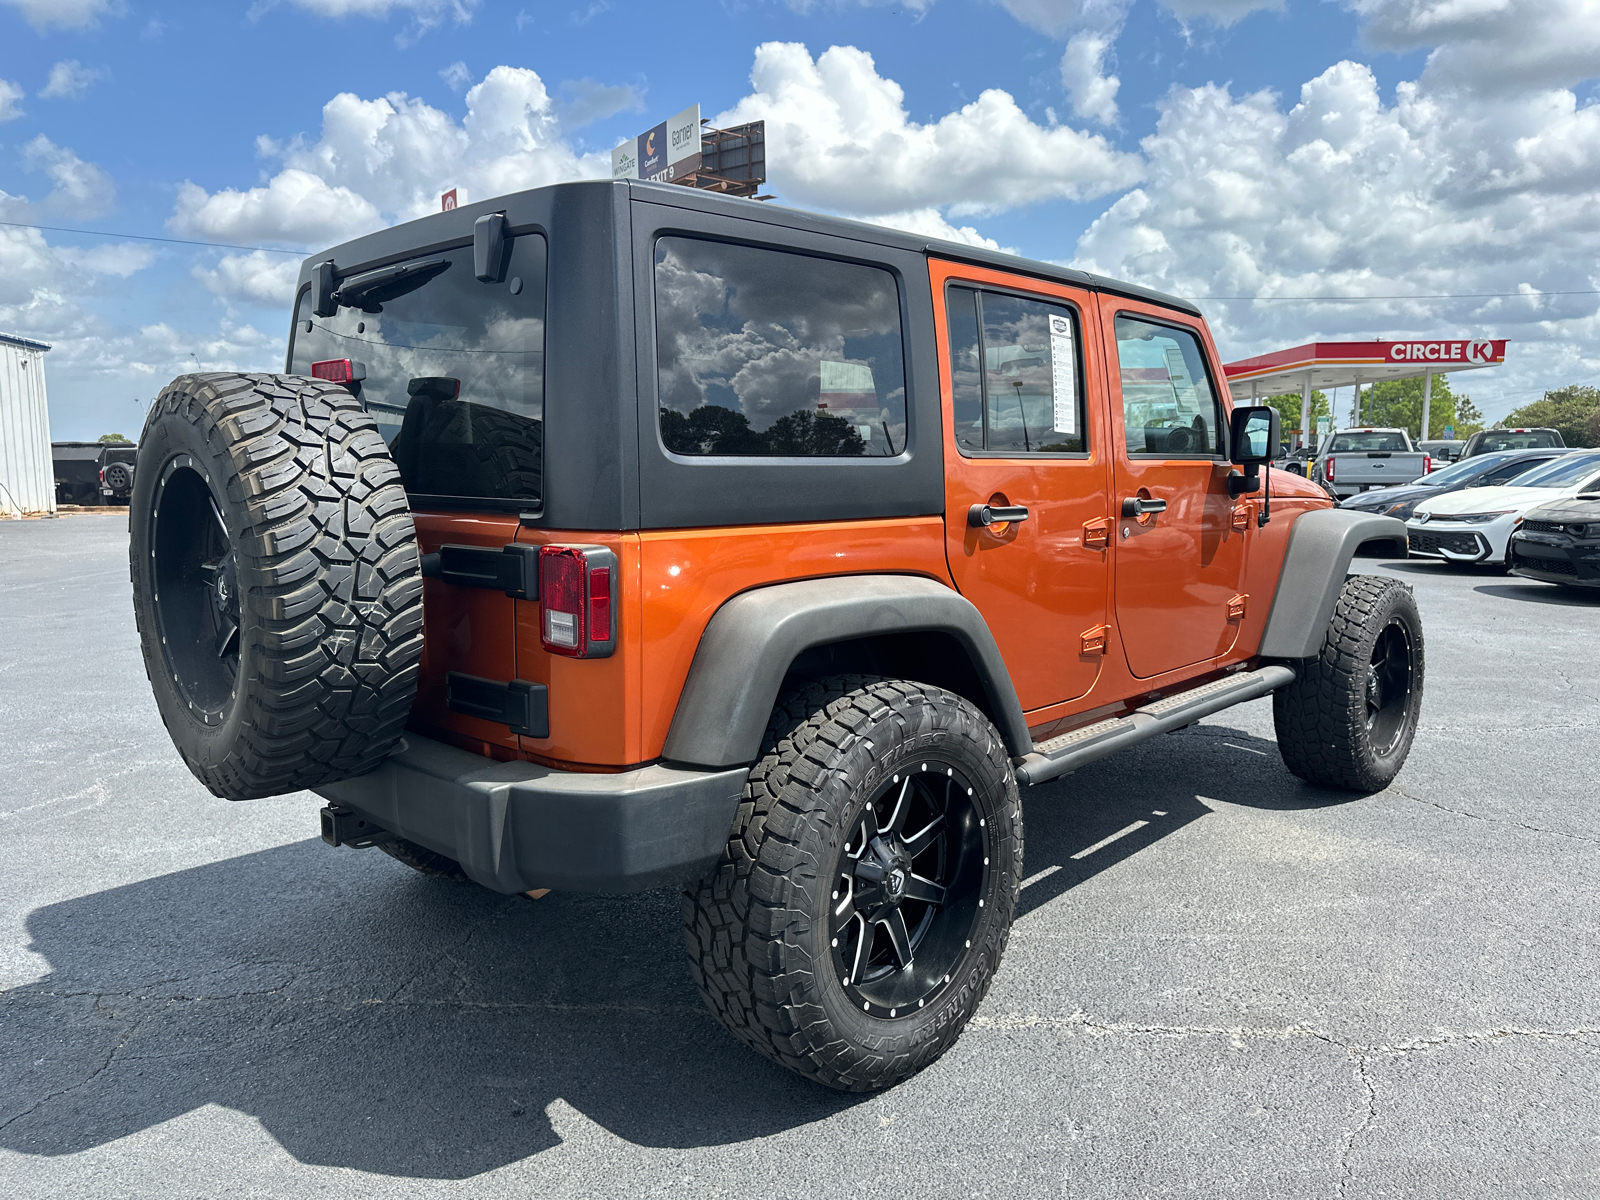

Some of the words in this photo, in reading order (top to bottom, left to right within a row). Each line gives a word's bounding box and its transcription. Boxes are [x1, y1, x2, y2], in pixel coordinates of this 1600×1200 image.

[671, 123, 694, 147] Garner
[613, 158, 635, 176] WINGATE
[651, 168, 668, 182] EXIT
[669, 166, 675, 178] 9
[1390, 343, 1462, 360] CIRCLE
[1472, 343, 1491, 362] K
[829, 766, 877, 848] TOYO
[880, 732, 947, 769] TIRES
[909, 952, 988, 1048] COUNTRY
